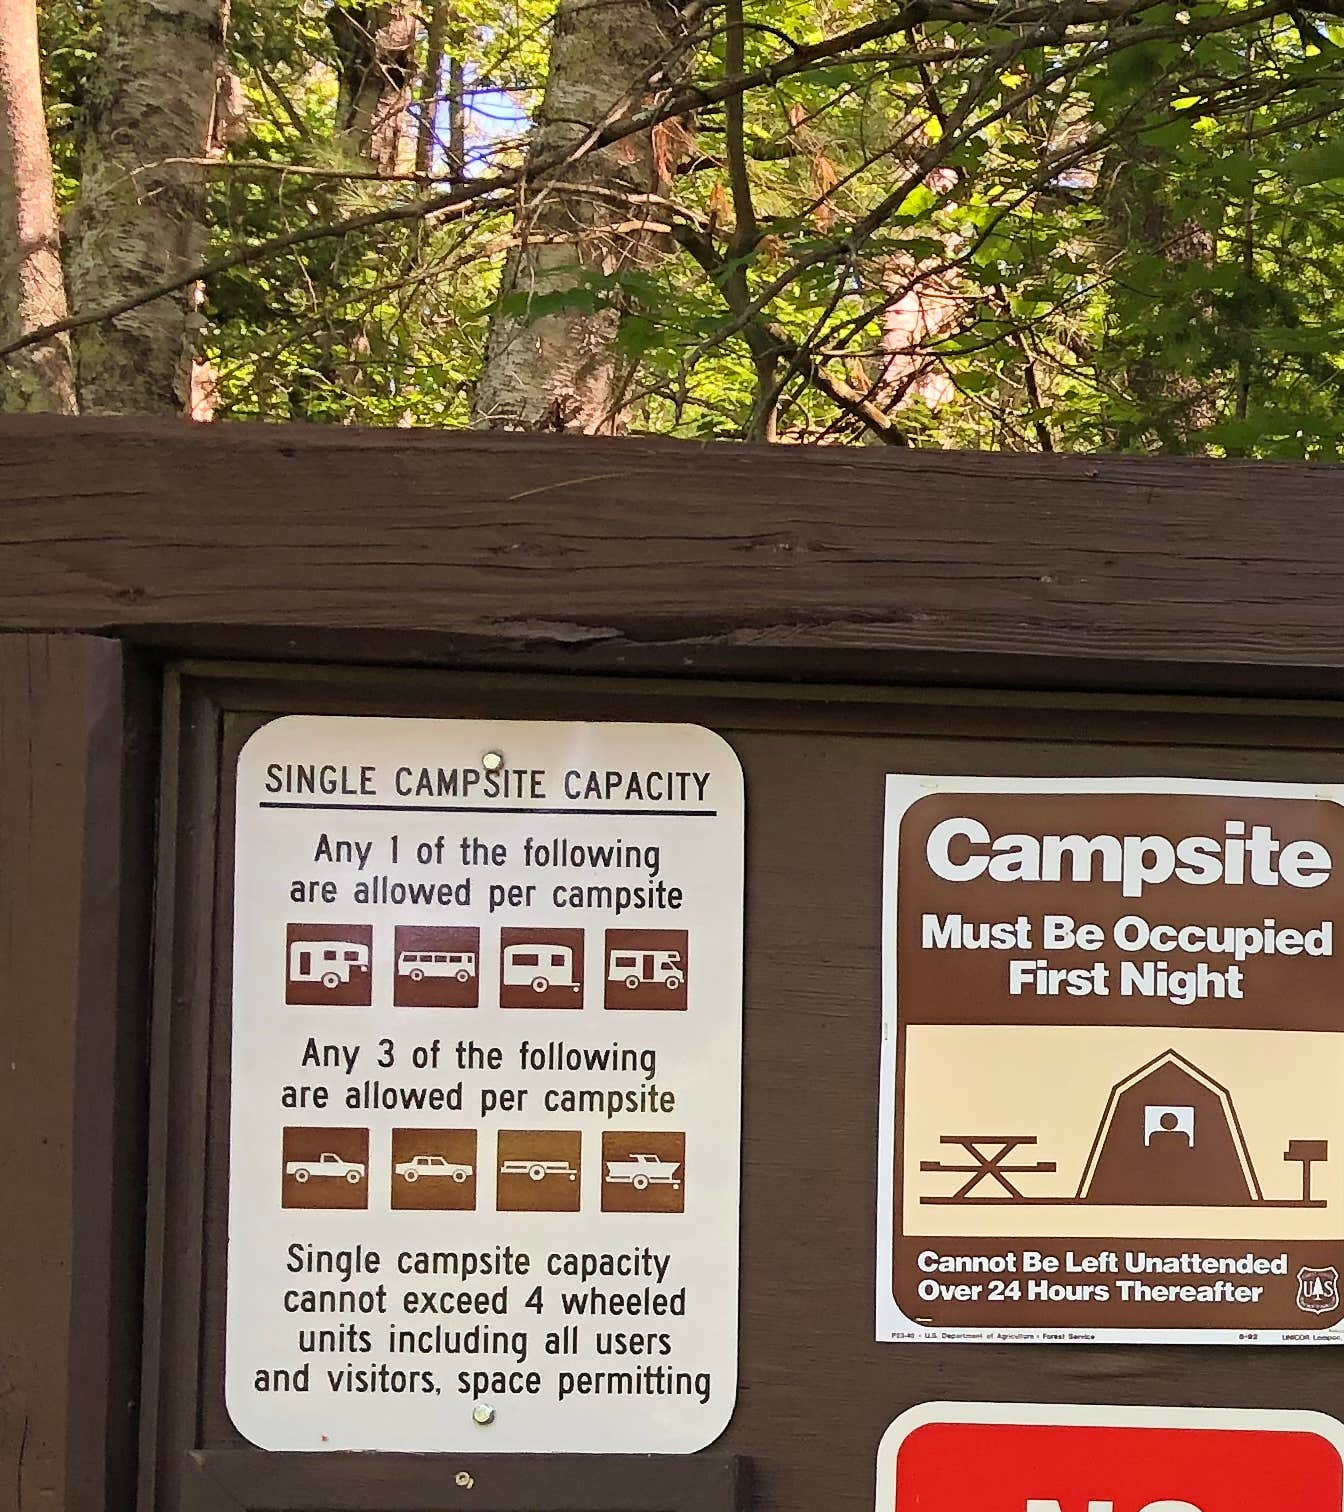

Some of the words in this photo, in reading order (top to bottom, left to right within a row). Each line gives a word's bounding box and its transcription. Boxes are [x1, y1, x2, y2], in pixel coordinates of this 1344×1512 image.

[265, 764, 376, 795] SINGLE
[399, 767, 547, 800] CAMPSITE
[565, 770, 710, 801] CAPACITY
[314, 833, 372, 870] Any
[390, 837, 399, 866] 1
[417, 836, 445, 864] of
[460, 837, 507, 866] the
[524, 837, 659, 878] following
[927, 818, 1332, 897] Campsite
[290, 881, 337, 903] are
[354, 875, 470, 906] allowed
[489, 885, 536, 913] per
[553, 880, 682, 915] campsite
[922, 914, 1032, 949] Must
[1044, 915, 1104, 950] Be
[1114, 916, 1332, 961] Occupied
[1010, 960, 1109, 995] First
[1121, 961, 1243, 1005] Night
[287, 1243, 380, 1282] Single
[398, 1245, 530, 1281] campsite
[547, 1247, 671, 1284] capacity
[918, 1251, 1016, 1272] Cannot
[1023, 1252, 1059, 1272] Be
[1066, 1252, 1118, 1272] Left
[1126, 1252, 1287, 1274] Unattended
[284, 1284, 387, 1313] cannot
[403, 1285, 507, 1314] exceed
[525, 1286, 543, 1314] 4
[561, 1287, 685, 1316] wheeled
[918, 1279, 982, 1300] Over
[988, 1280, 1021, 1300] 24
[1028, 1280, 1109, 1301] Hours
[1116, 1281, 1263, 1302] Thereafter
[254, 1363, 309, 1392] and
[327, 1364, 441, 1395] visitors,
[458, 1371, 541, 1401] space
[559, 1365, 710, 1404] permitting
